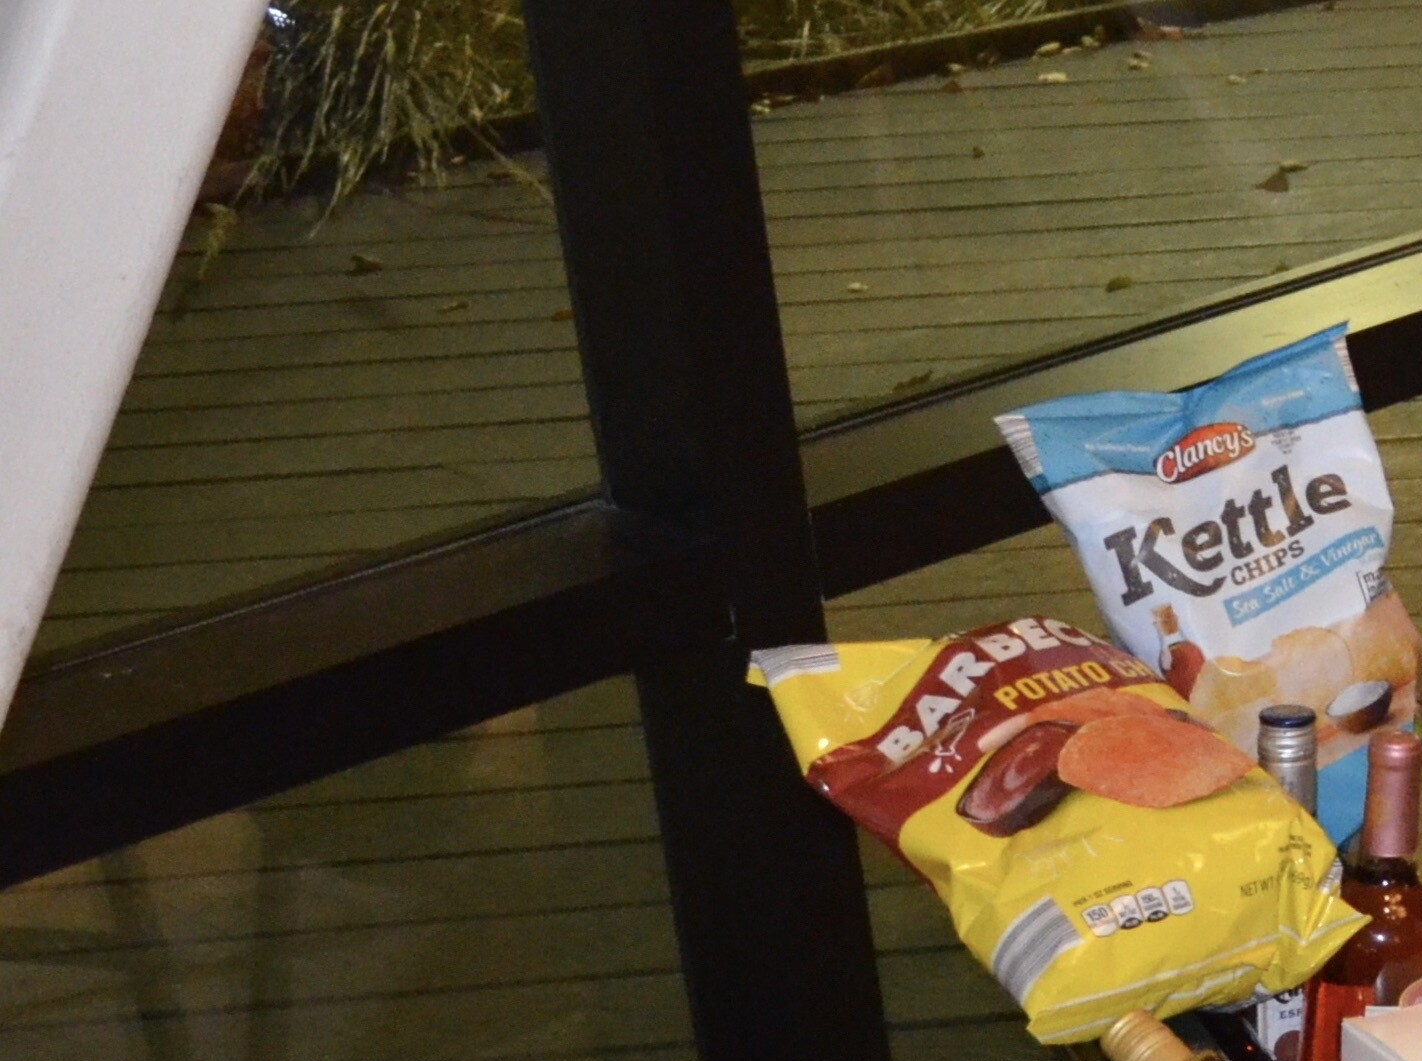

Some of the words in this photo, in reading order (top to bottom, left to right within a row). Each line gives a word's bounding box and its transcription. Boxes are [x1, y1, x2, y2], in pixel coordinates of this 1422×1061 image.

[1157, 424, 1254, 483] Clancy's
[1105, 464, 1353, 606] Kettle
[1231, 540, 1304, 586] CHIPS
[1232, 599, 1260, 618] Sea
[1263, 575, 1296, 600] Salt
[1300, 563, 1319, 580] &
[1321, 533, 1378, 566] Vinegar
[876, 617, 1097, 763] BARBEC
[993, 660, 1112, 710] POTATO
